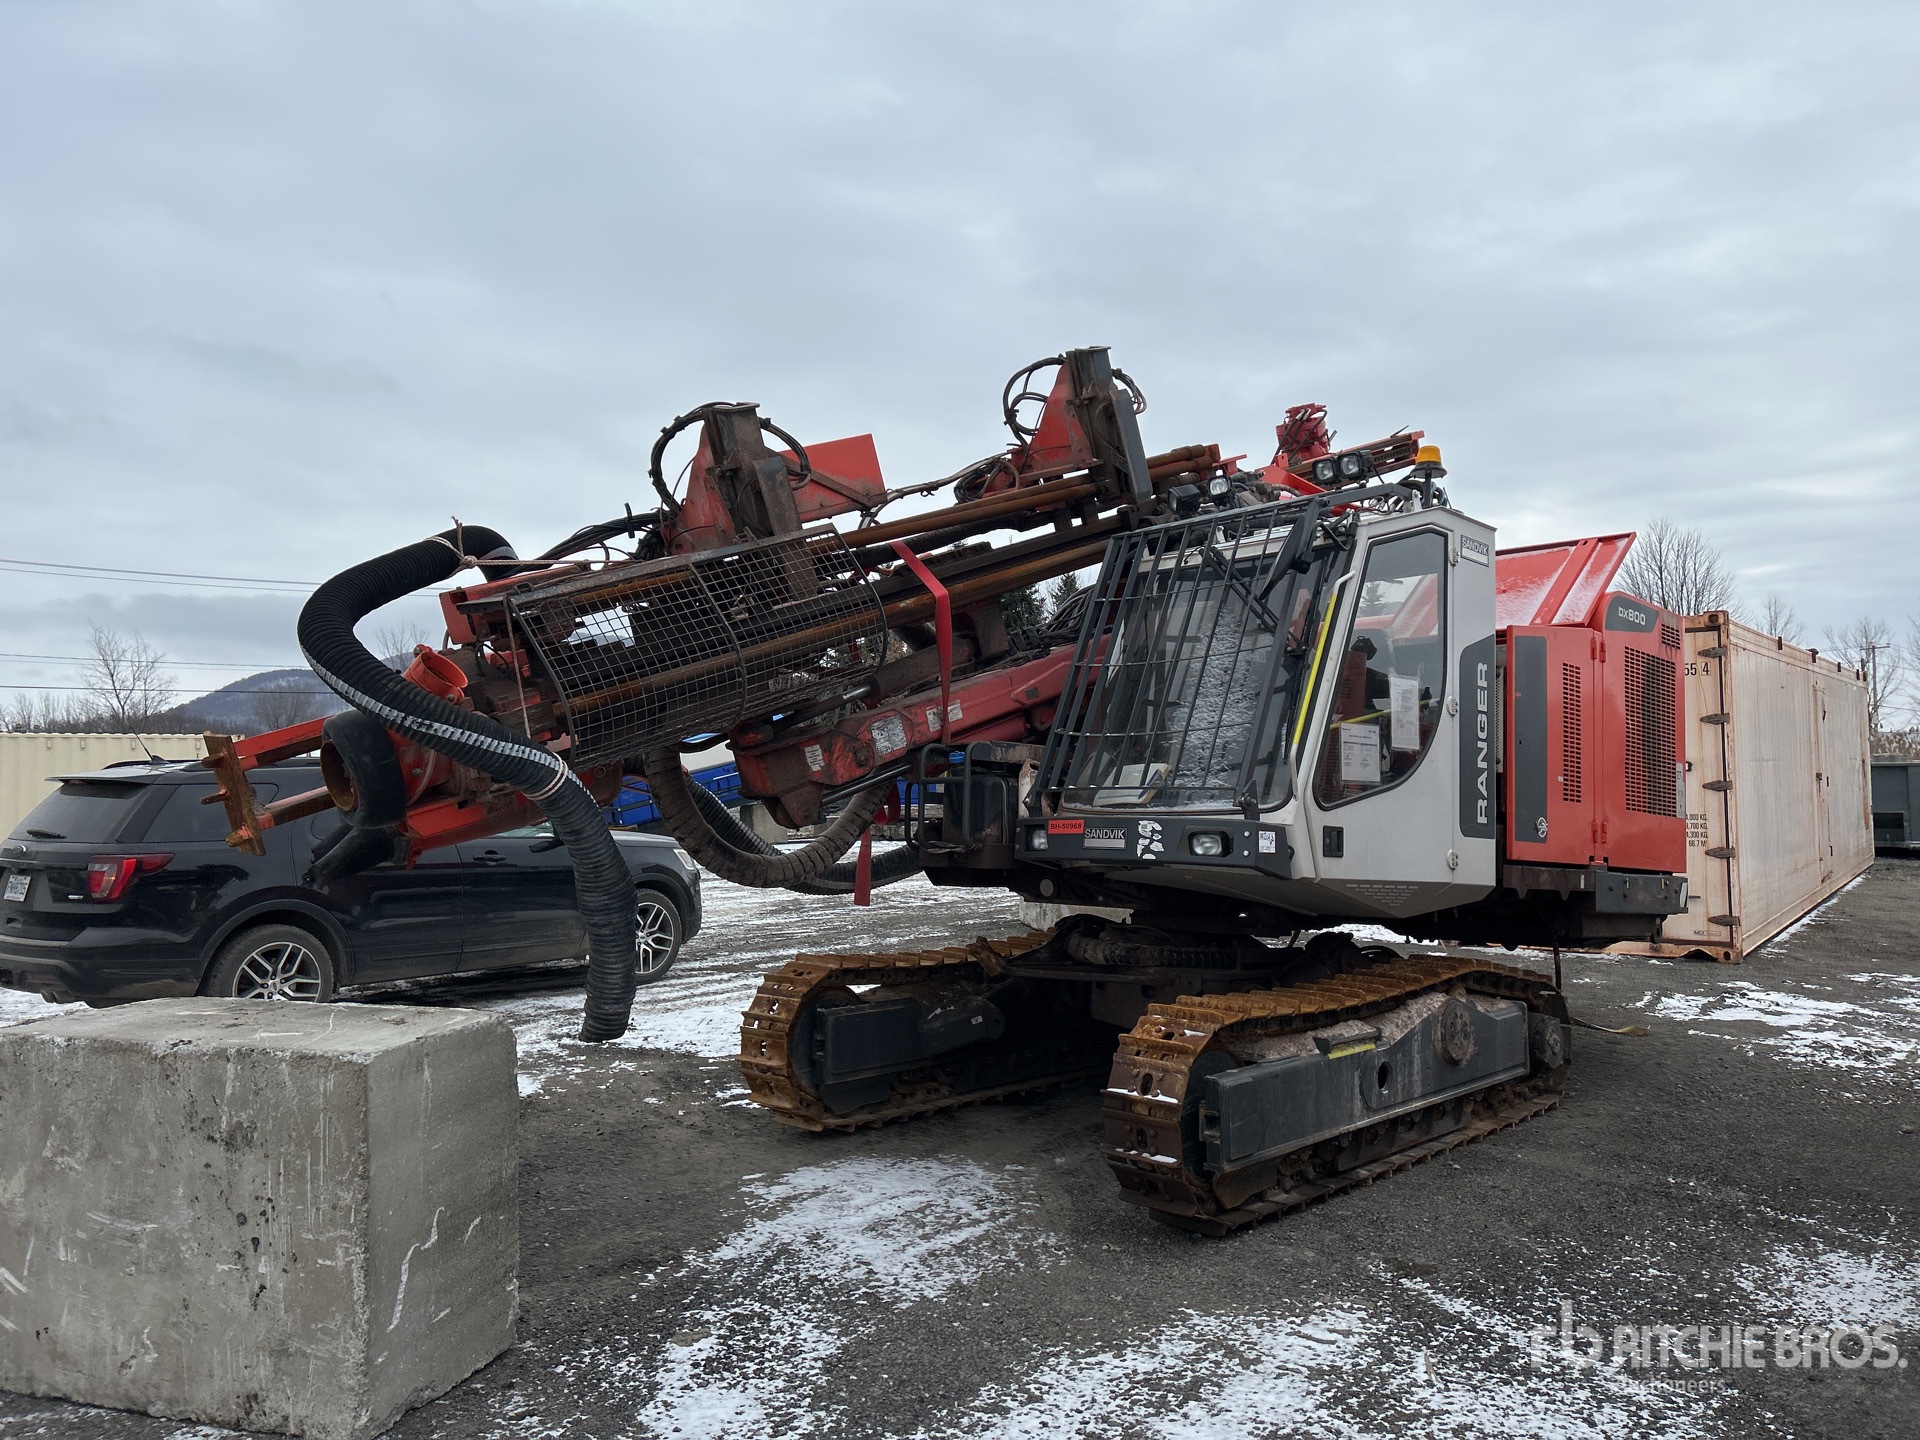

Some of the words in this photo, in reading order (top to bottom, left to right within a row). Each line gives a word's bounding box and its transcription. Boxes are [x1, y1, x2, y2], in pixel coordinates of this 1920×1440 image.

[1462, 537, 1488, 556] SANDVIK
[1702, 662, 1710, 675] 4
[1477, 662, 1488, 824] RANGER
[1085, 828, 1125, 839] SANDVIK
